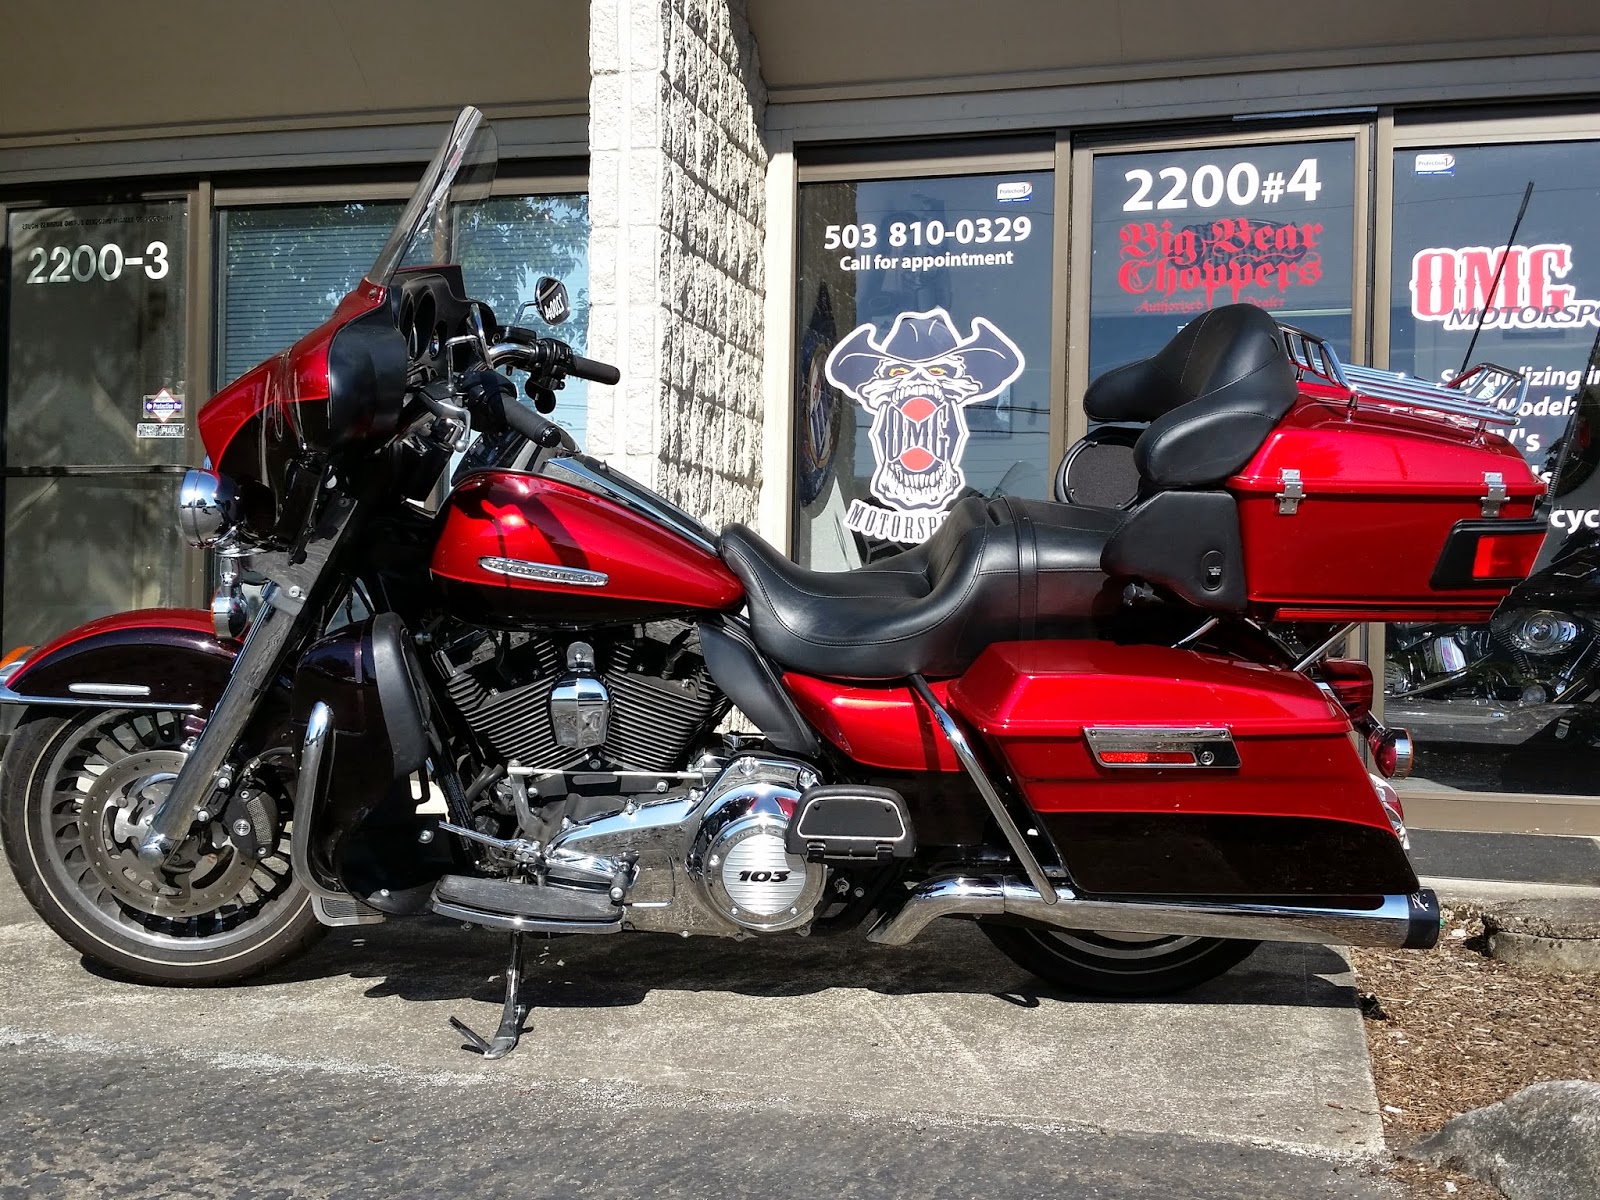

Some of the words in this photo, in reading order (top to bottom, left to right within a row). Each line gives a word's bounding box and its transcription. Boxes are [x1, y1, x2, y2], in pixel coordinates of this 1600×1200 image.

[1122, 158, 1321, 212] 2200#4
[824, 223, 877, 250] 503
[888, 216, 1031, 246] 810-0329
[1119, 219, 1204, 265] Big
[1203, 217, 1324, 259] Bear
[26, 241, 169, 284] 2200-3
[839, 254, 871, 271] Call
[873, 253, 899, 269] for
[901, 250, 1013, 272] appointment
[1118, 251, 1323, 310] Choppers
[1412, 246, 1573, 319] OMG
[1135, 299, 1203, 315] Authorized
[886, 403, 950, 462] OMG
[847, 503, 948, 540] MOTORSP
[738, 870, 791, 883] 103
